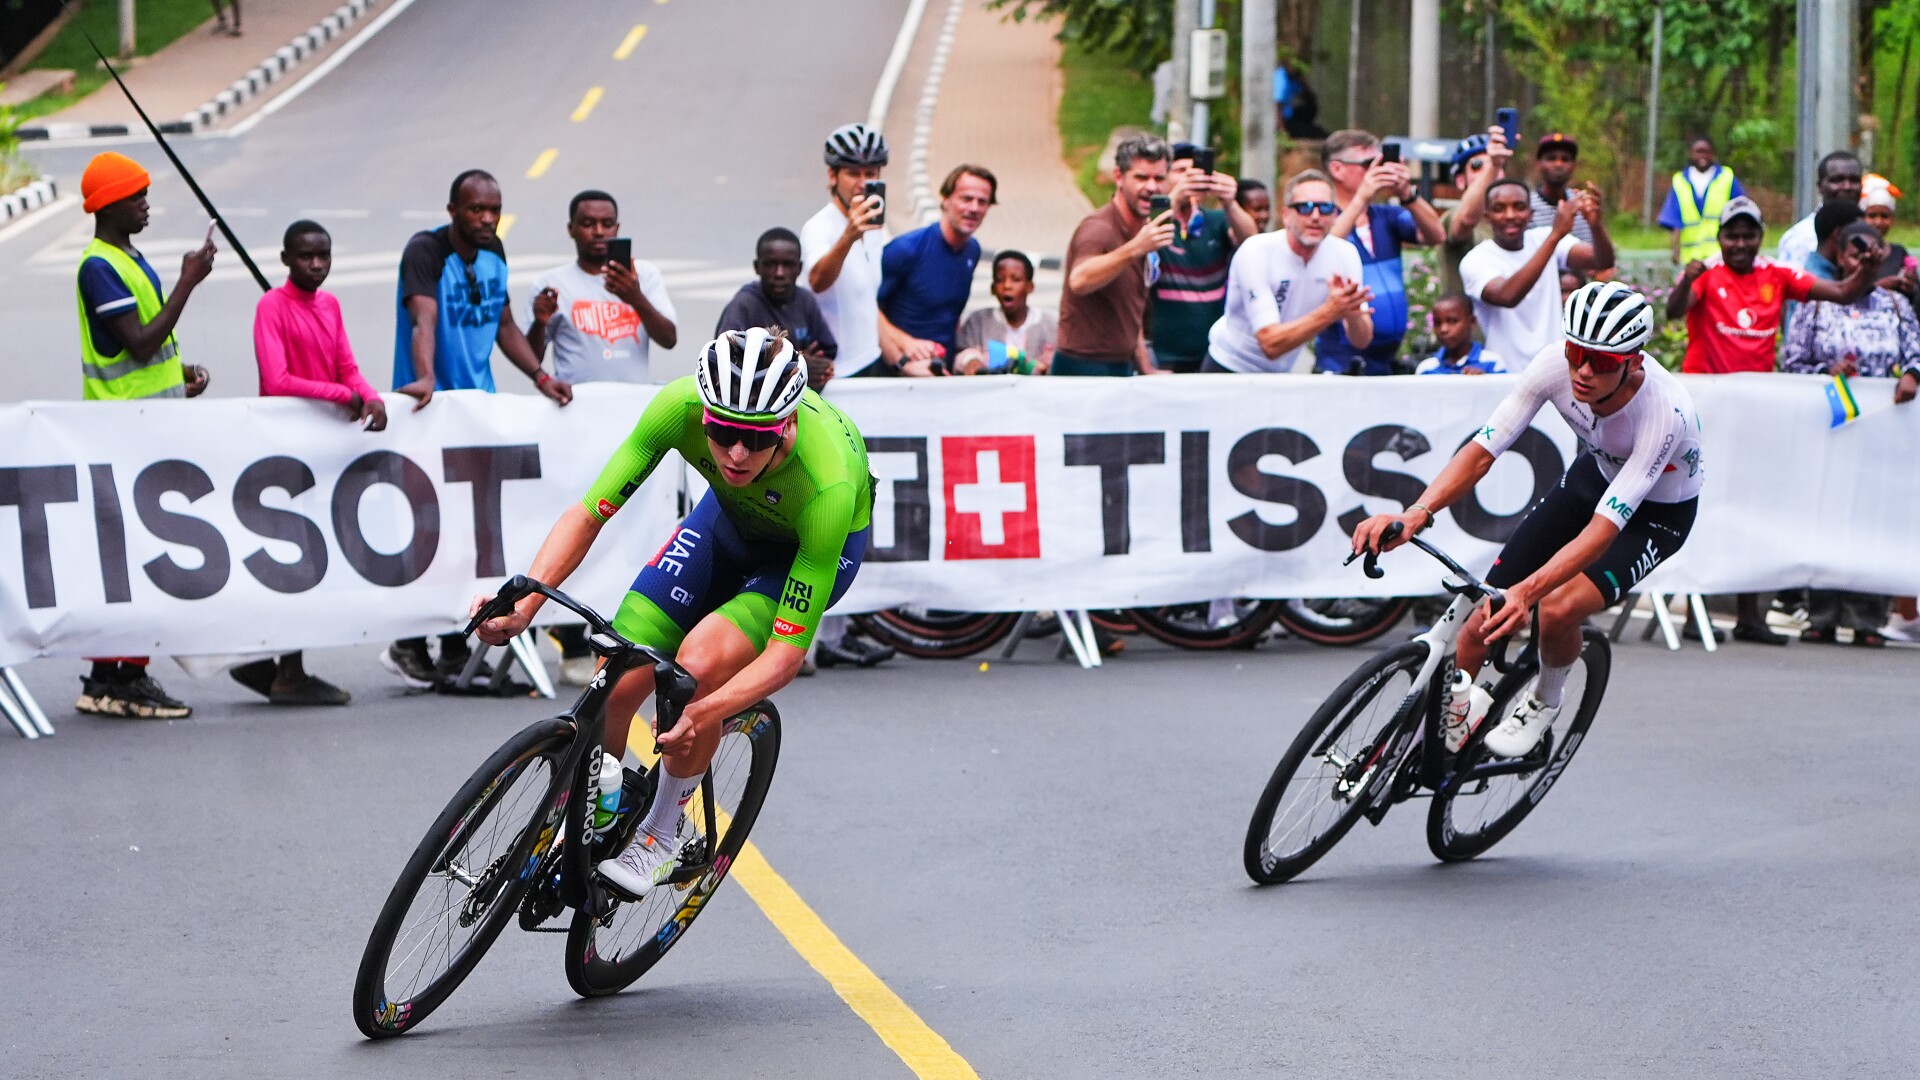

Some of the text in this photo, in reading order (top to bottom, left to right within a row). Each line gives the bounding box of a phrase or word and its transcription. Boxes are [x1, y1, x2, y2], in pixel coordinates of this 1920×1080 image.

[698, 357, 710, 392] MET
[783, 369, 804, 403] MET
[1063, 424, 1580, 556] TISSO
[0, 444, 542, 609] TISSOT
[657, 528, 702, 577] UAE
[1630, 538, 1661, 585] UAE
[782, 591, 810, 614] MO
[788, 576, 813, 600] TRI
[774, 620, 795, 634] MOL
[581, 744, 602, 846] COLNAGO
